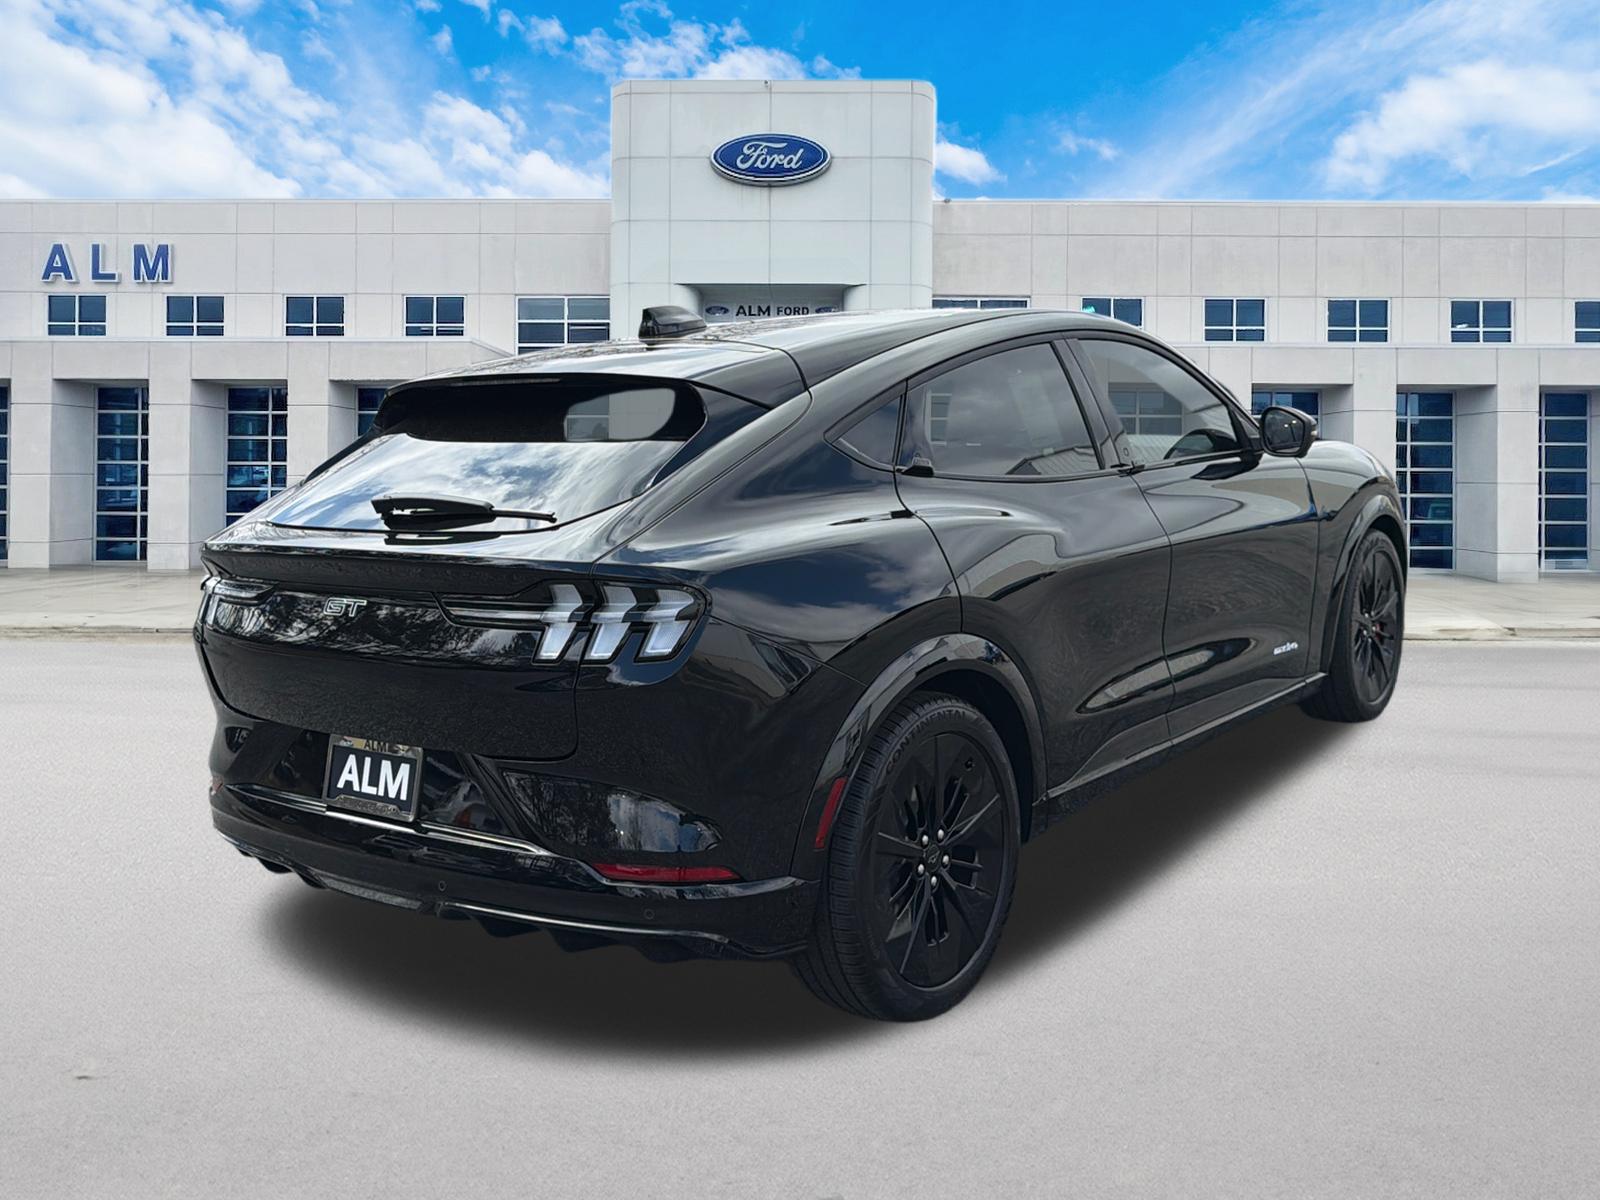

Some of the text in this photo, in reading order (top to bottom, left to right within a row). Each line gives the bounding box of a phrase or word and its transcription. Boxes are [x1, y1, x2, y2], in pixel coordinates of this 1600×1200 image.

[736, 141, 804, 169] Ford
[41, 242, 172, 282] ALM
[735, 305, 771, 317] ALM
[776, 306, 810, 316] FORD
[323, 598, 368, 617] GT
[886, 708, 966, 775] CONTINENTAL
[336, 753, 411, 801] ALM
